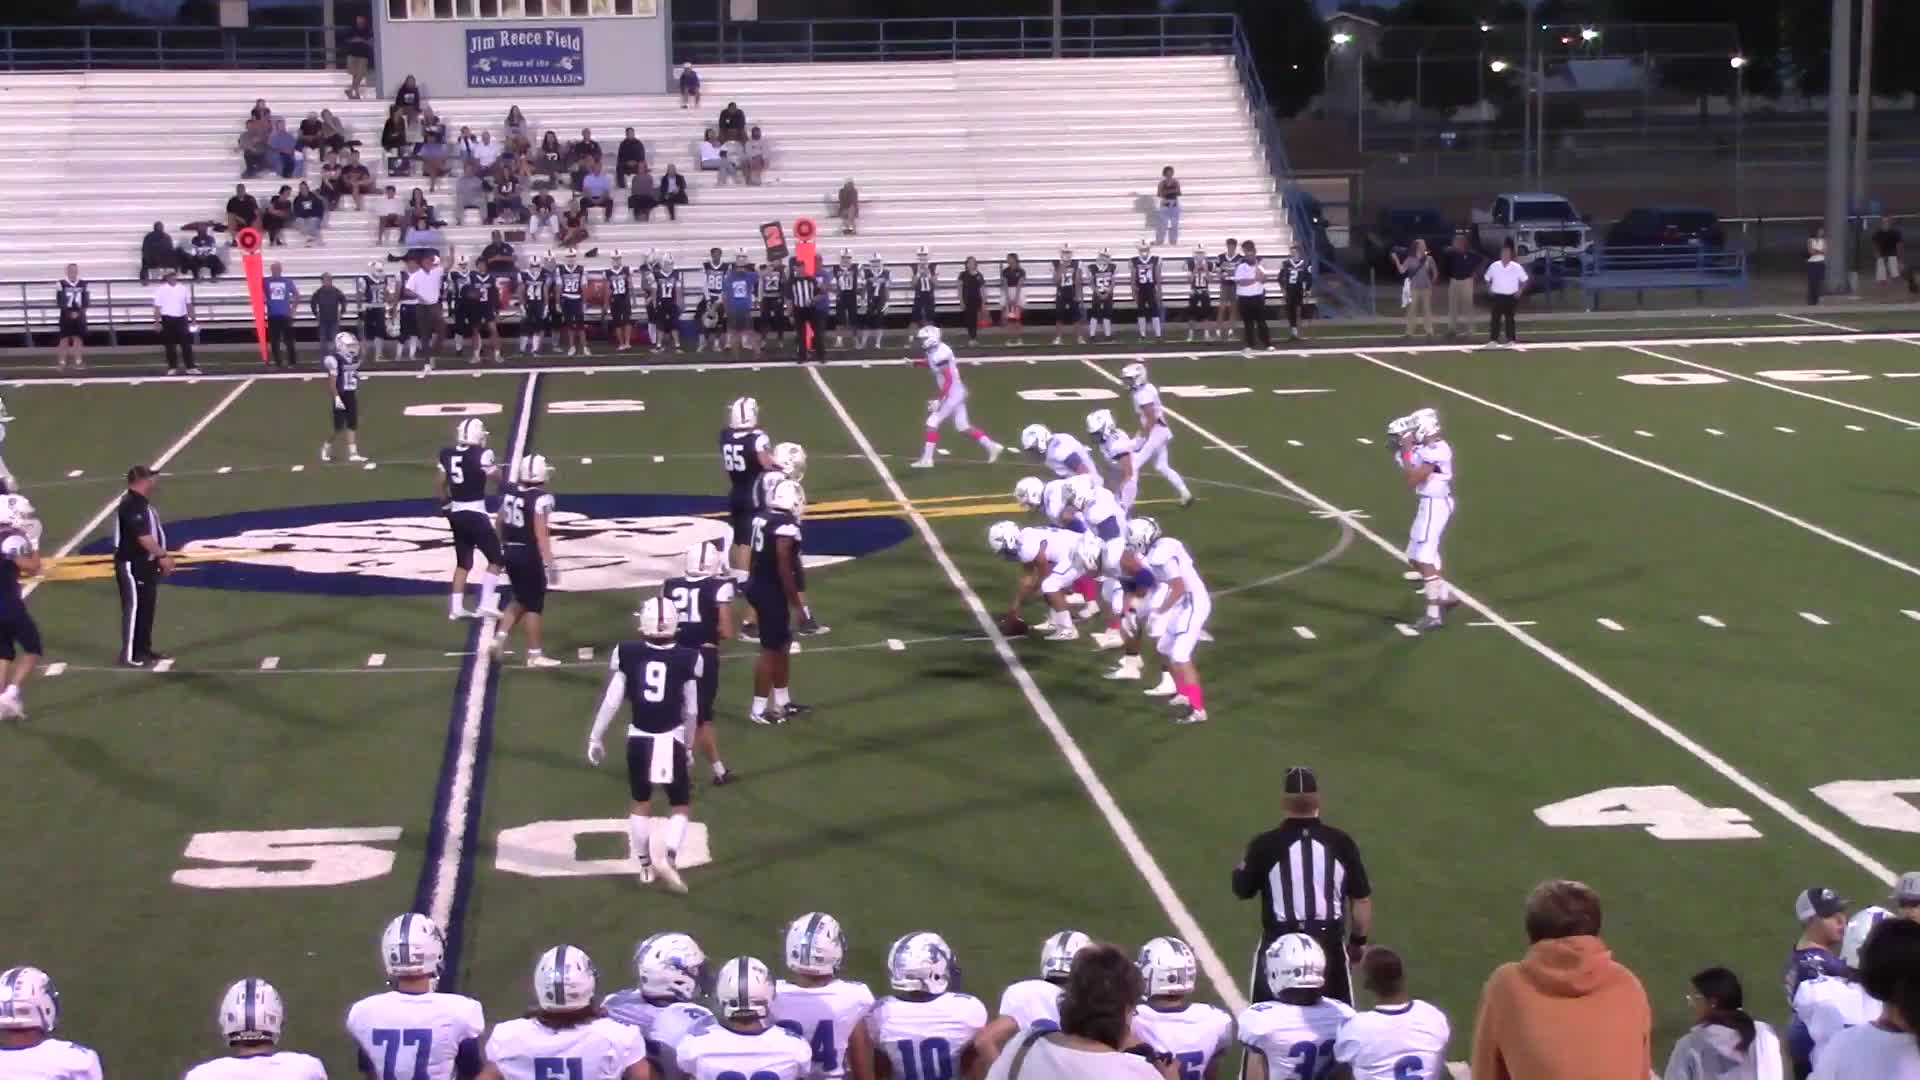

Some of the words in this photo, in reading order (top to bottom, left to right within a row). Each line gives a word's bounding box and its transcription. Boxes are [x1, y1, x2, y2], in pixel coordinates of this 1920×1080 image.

[470, 36, 495, 53] Jim
[500, 30, 542, 46] Reece
[545, 30, 580, 51] Field
[471, 75, 517, 85] HASKELL
[766, 226, 781, 248] 2
[450, 455, 464, 484] 5
[723, 443, 747, 472] 65
[502, 493, 524, 528] 56
[672, 587, 701, 623] 21
[643, 660, 667, 703] 9
[372, 1029, 433, 1080] 77
[897, 1037, 953, 1080] 10
